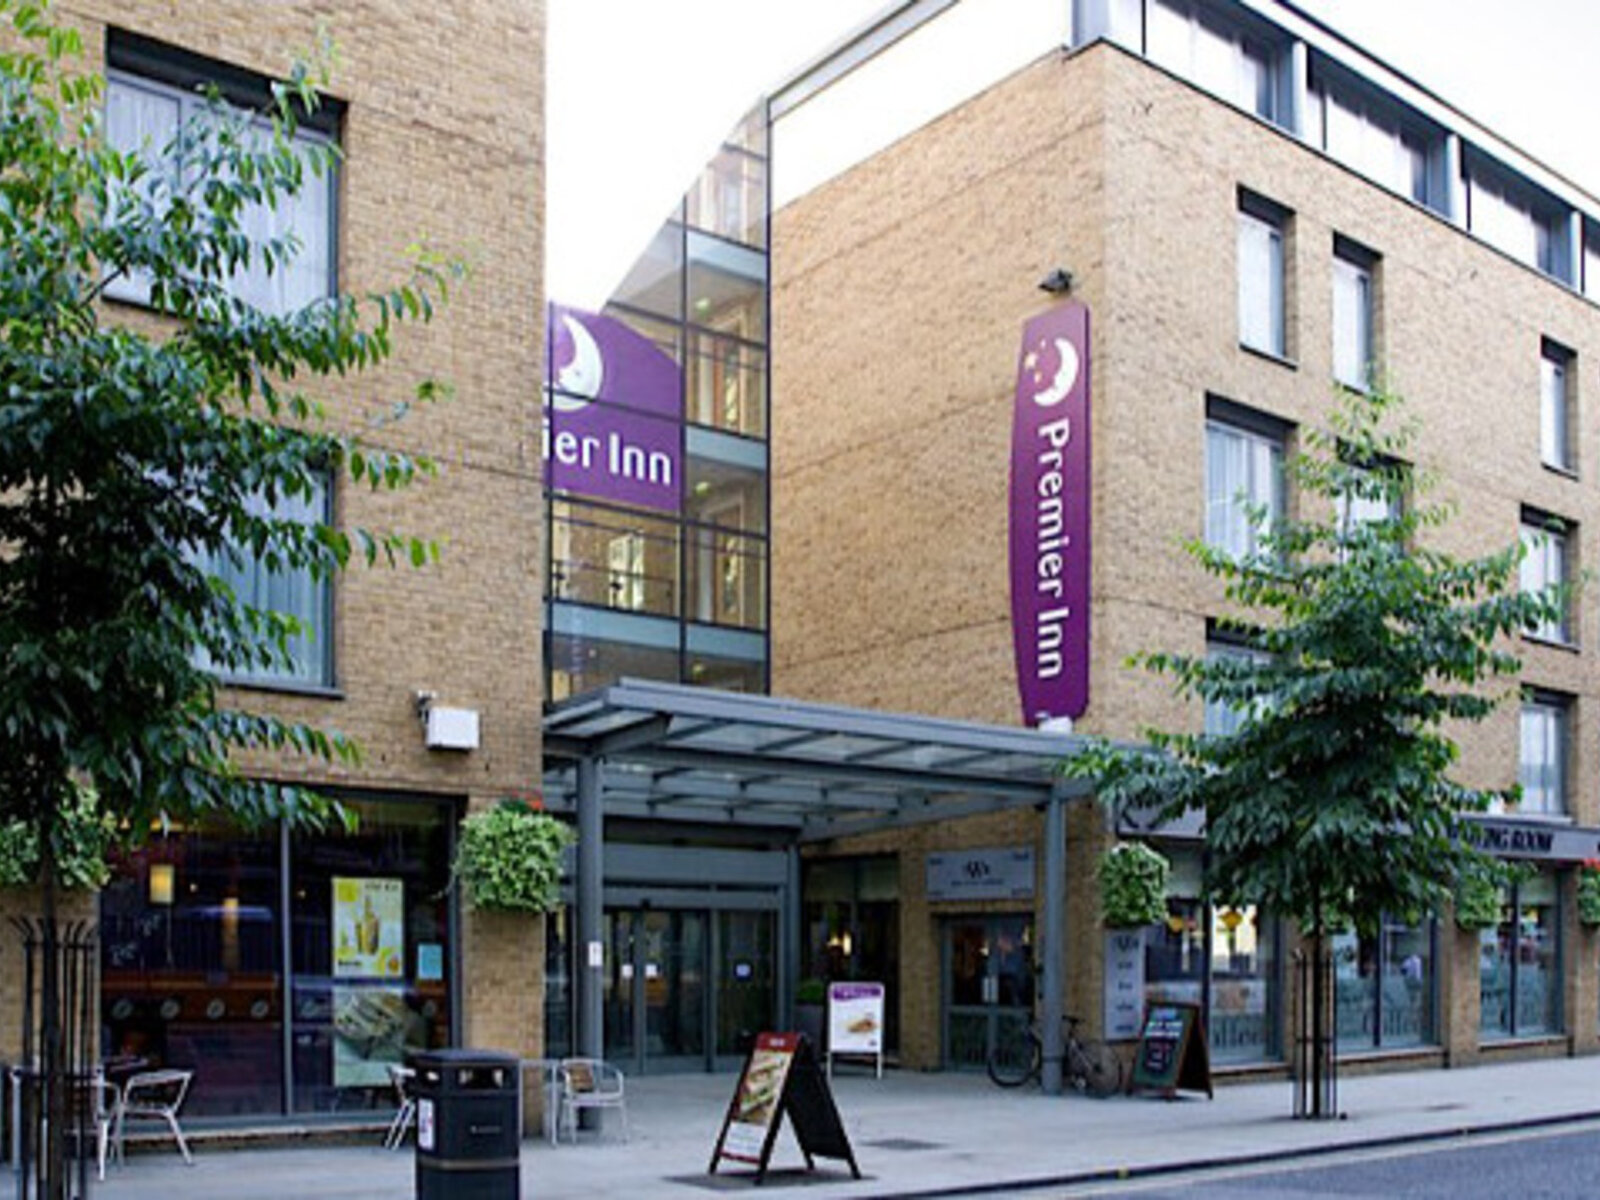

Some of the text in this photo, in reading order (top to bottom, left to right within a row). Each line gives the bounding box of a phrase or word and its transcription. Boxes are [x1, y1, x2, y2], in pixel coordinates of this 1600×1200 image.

[608, 432, 671, 486] Inn
[1038, 418, 1070, 678] Premier Inn
